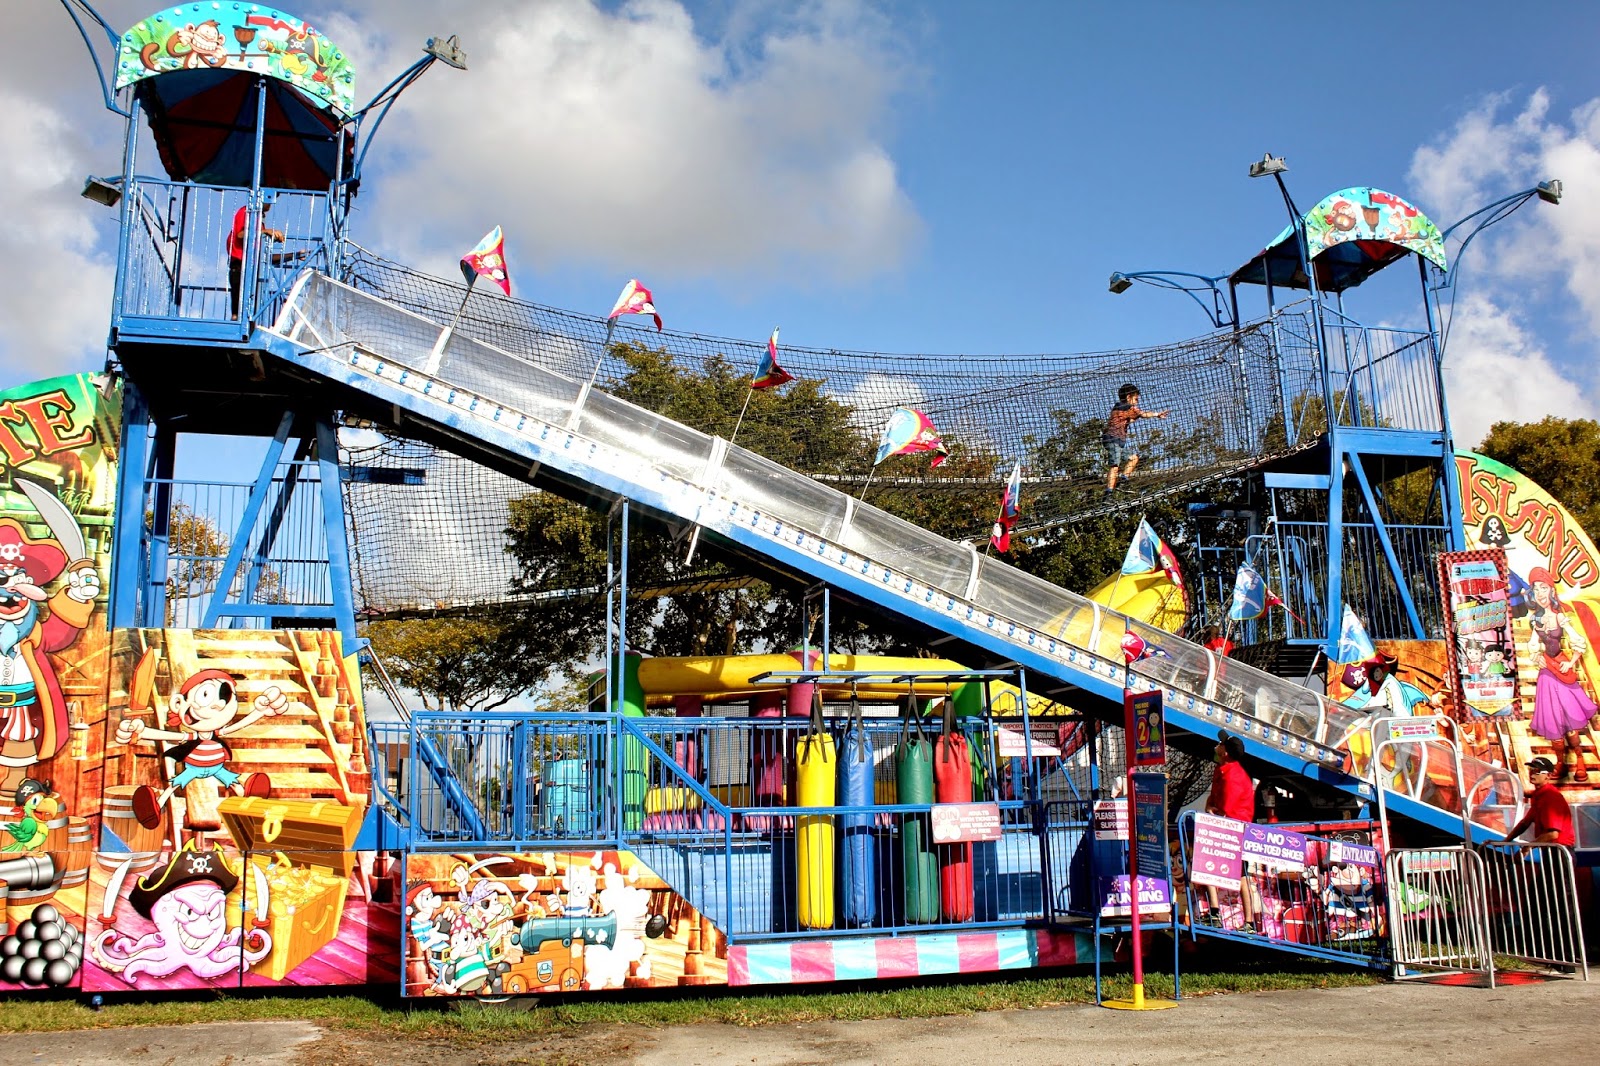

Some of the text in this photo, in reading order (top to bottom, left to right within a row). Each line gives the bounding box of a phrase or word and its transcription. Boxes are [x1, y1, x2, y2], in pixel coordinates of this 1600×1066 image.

[1454, 455, 1600, 589] ISLAND
[1138, 721, 1146, 741] 2
[934, 811, 958, 821] JOIN
[1095, 811, 1116, 820] PLEASE
[1200, 815, 1239, 829] IMPORTANT
[1100, 821, 1126, 829] SLIPPERY
[1198, 828, 1240, 844] NO SMOKING,
[1267, 832, 1285, 846] NO
[1196, 836, 1214, 846] FOOD
[1221, 843, 1242, 852] DRINK
[1243, 839, 1305, 862] OPEN-TOED SHOES
[1201, 847, 1236, 860] ALLOWED
[1342, 846, 1376, 864] ENTRANCE
